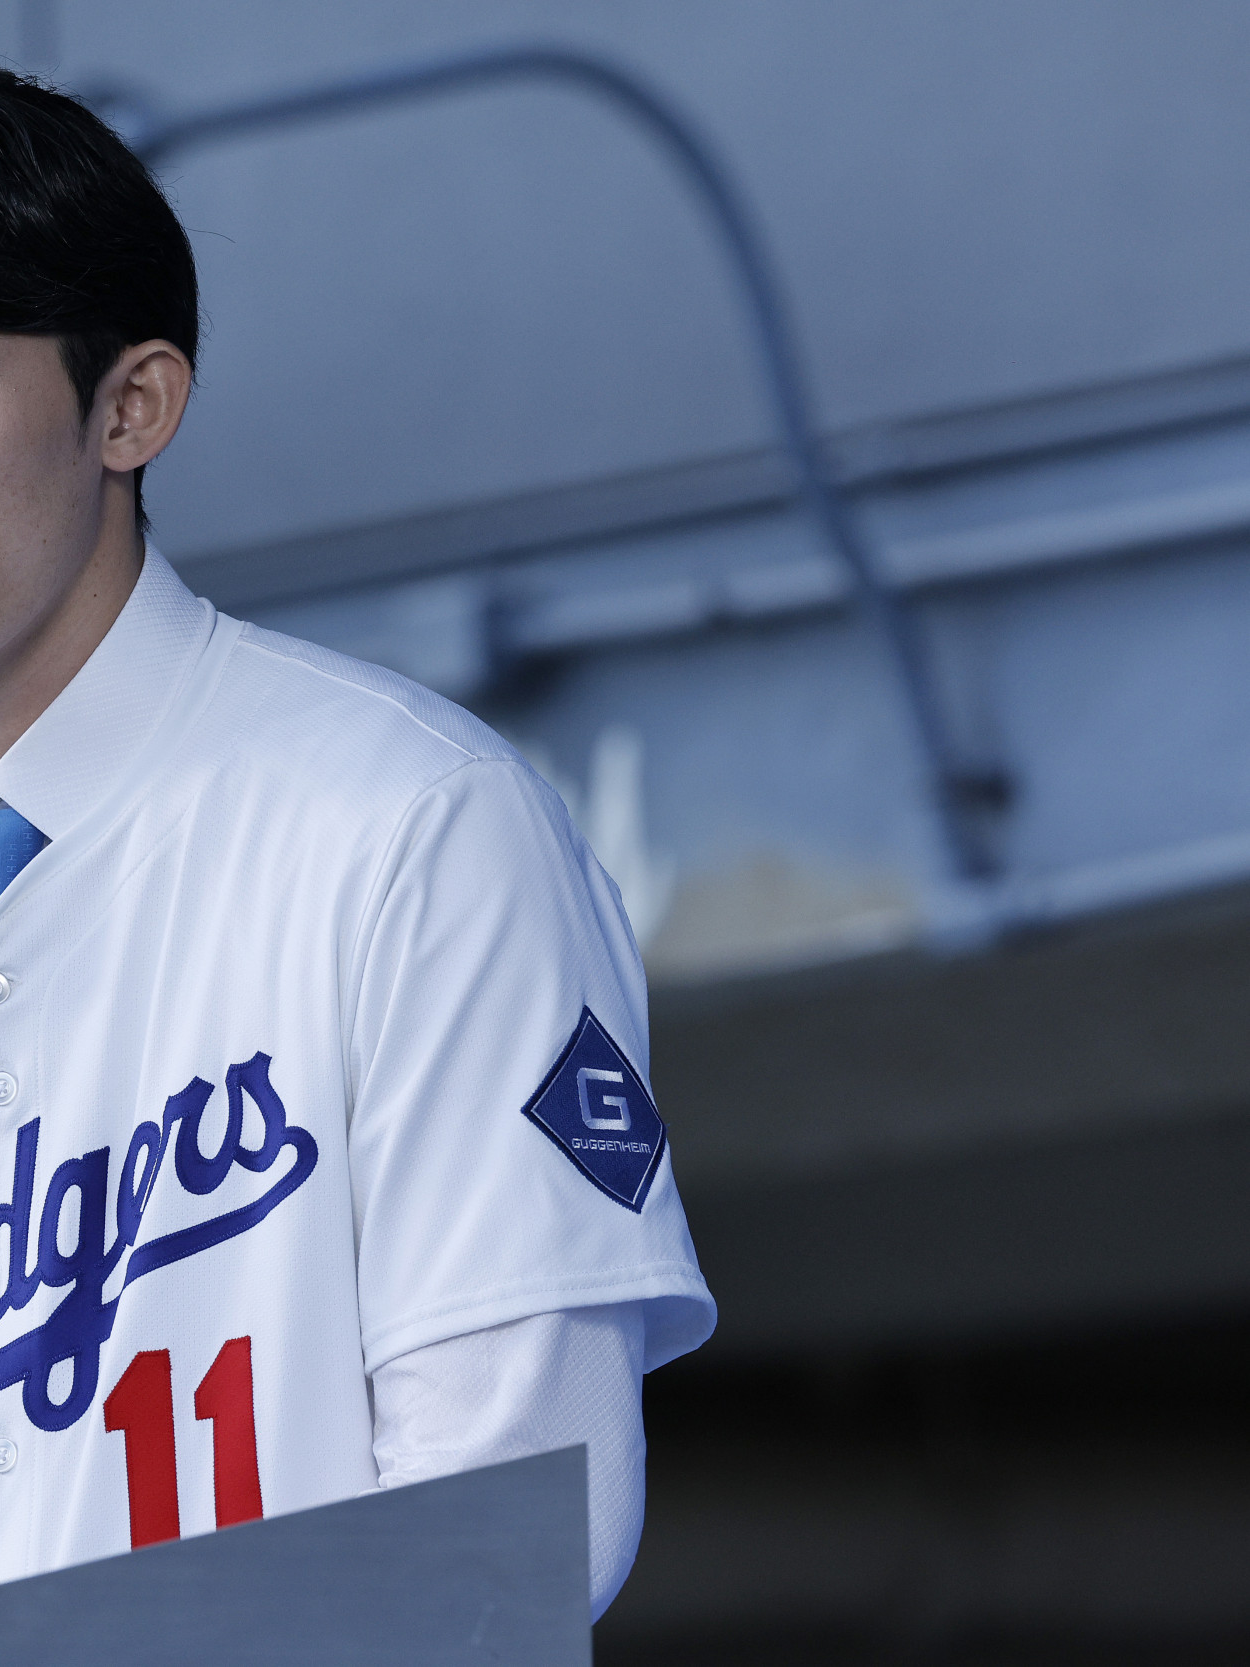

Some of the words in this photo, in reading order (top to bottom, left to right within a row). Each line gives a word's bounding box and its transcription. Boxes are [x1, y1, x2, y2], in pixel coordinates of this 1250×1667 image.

[576, 1066, 632, 1132] G
[571, 1137, 652, 1154] GUGGENHEIM
[103, 1335, 265, 1552] 11
